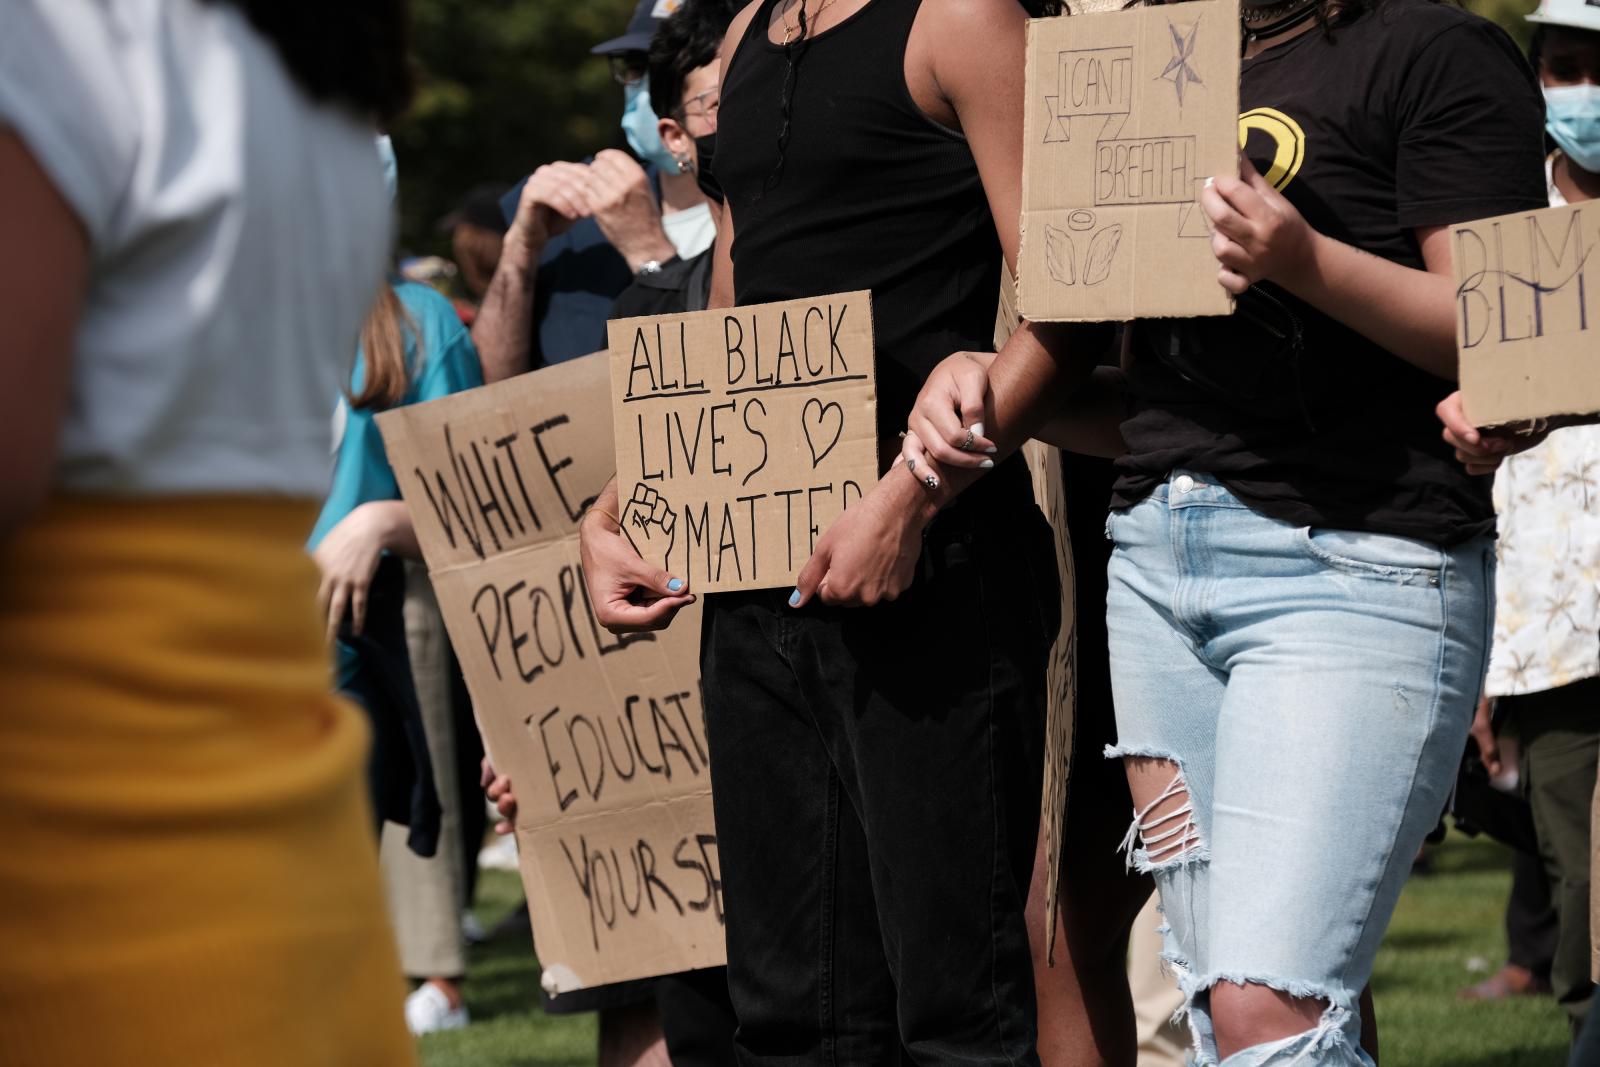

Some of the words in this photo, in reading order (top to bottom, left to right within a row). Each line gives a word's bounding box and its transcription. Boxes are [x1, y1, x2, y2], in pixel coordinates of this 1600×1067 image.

[1062, 61, 1068, 109] I
[1099, 141, 1186, 200] BREATH
[1456, 209, 1588, 349] BLM
[626, 322, 704, 397] ALL
[724, 304, 848, 385] BLACK
[638, 398, 768, 486] LIVES
[471, 564, 657, 684] PEOPL
[559, 833, 725, 953] YOURSE
